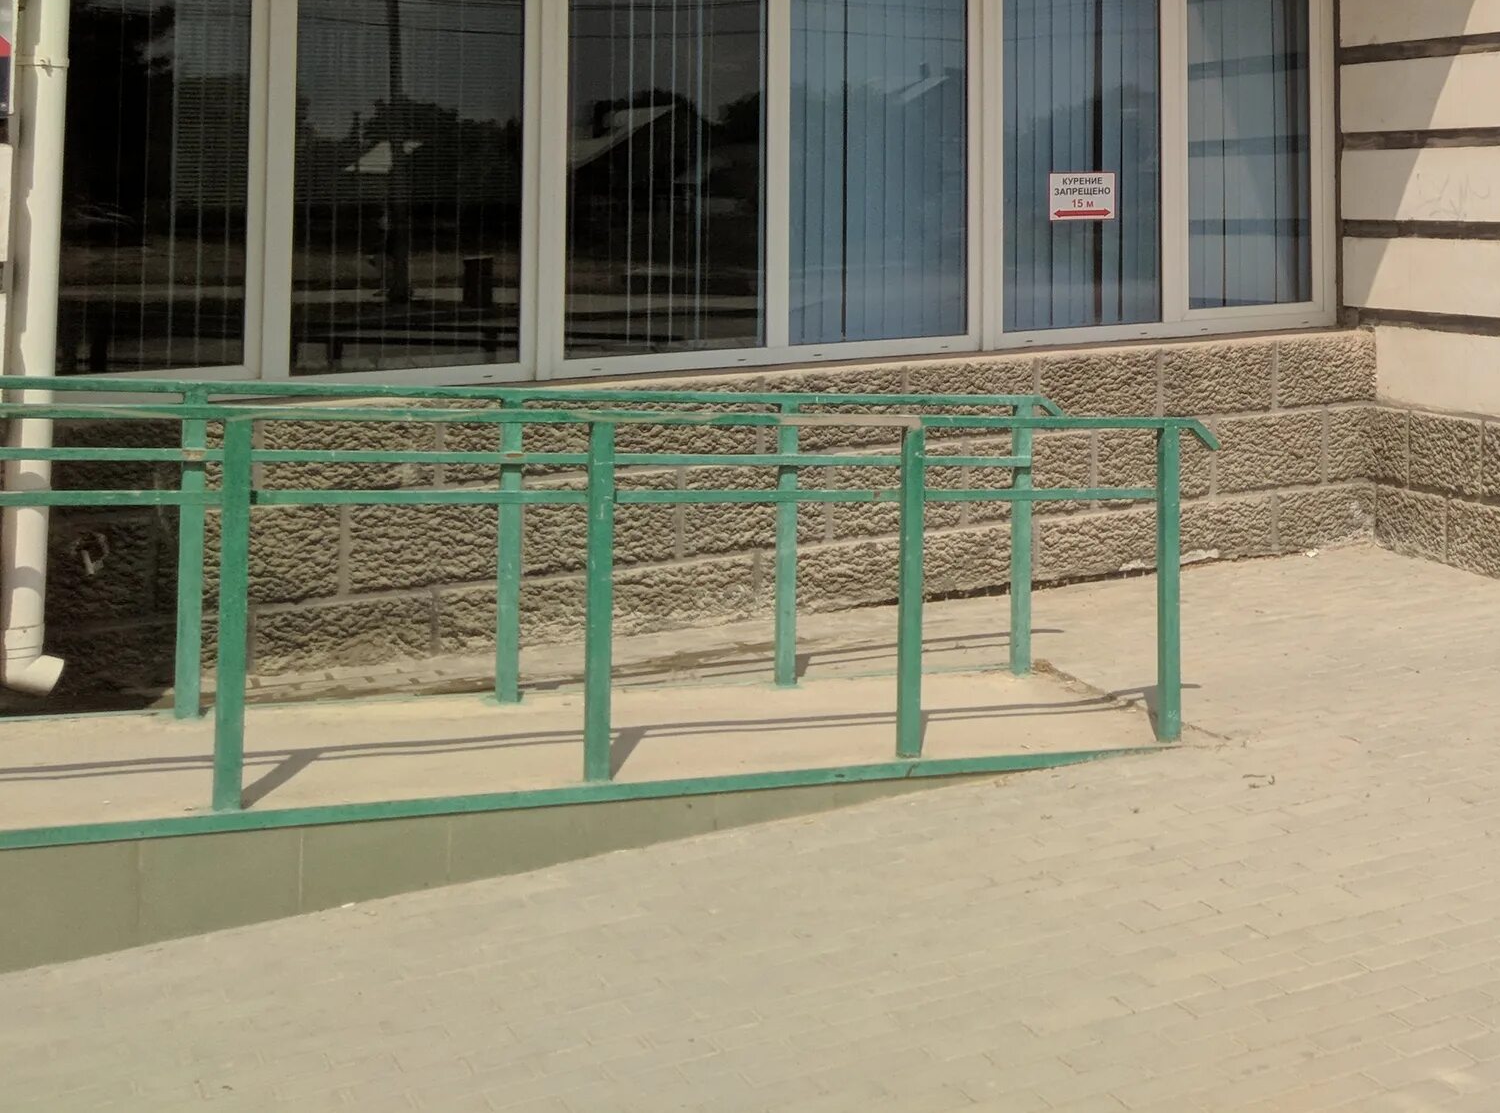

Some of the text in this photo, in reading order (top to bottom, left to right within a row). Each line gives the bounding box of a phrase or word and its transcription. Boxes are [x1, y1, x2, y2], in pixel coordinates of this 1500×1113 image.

[1062, 177, 1103, 185] КУРЕНИЕ
[1054, 187, 1111, 196] ЗАПРЕЩЕНО
[1072, 199, 1083, 208] 15
